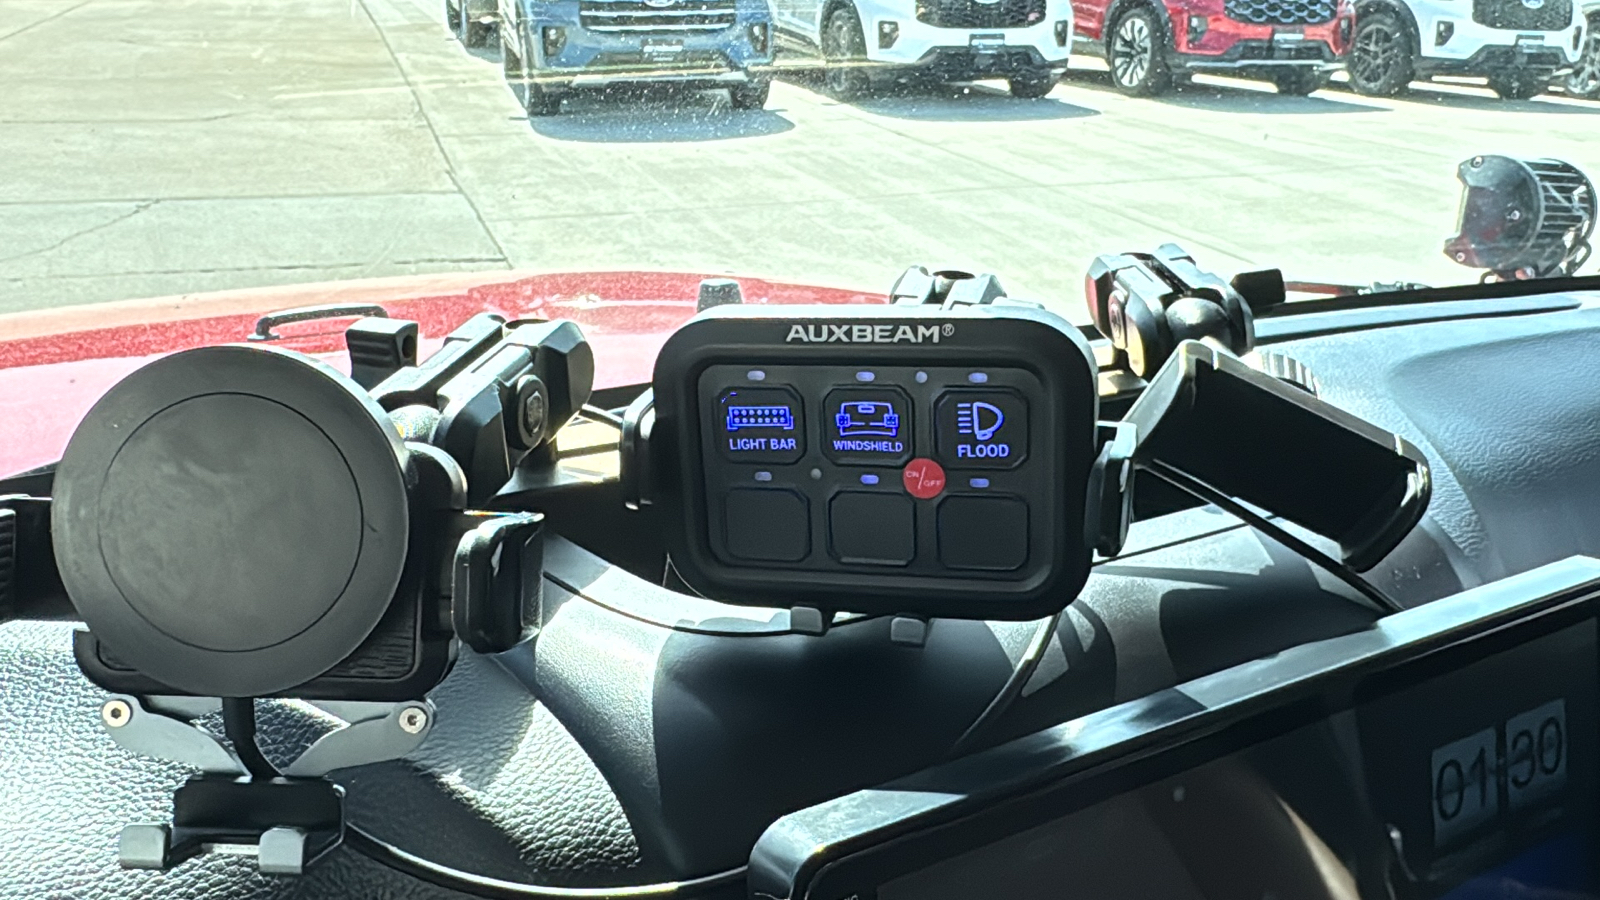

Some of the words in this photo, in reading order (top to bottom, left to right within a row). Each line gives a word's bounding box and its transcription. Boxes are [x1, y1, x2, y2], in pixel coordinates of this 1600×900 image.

[729, 438, 767, 451] LIGHT
[770, 438, 797, 451] BAR
[833, 440, 904, 453] WINDSHIELD
[957, 444, 1010, 458] FLOOD
